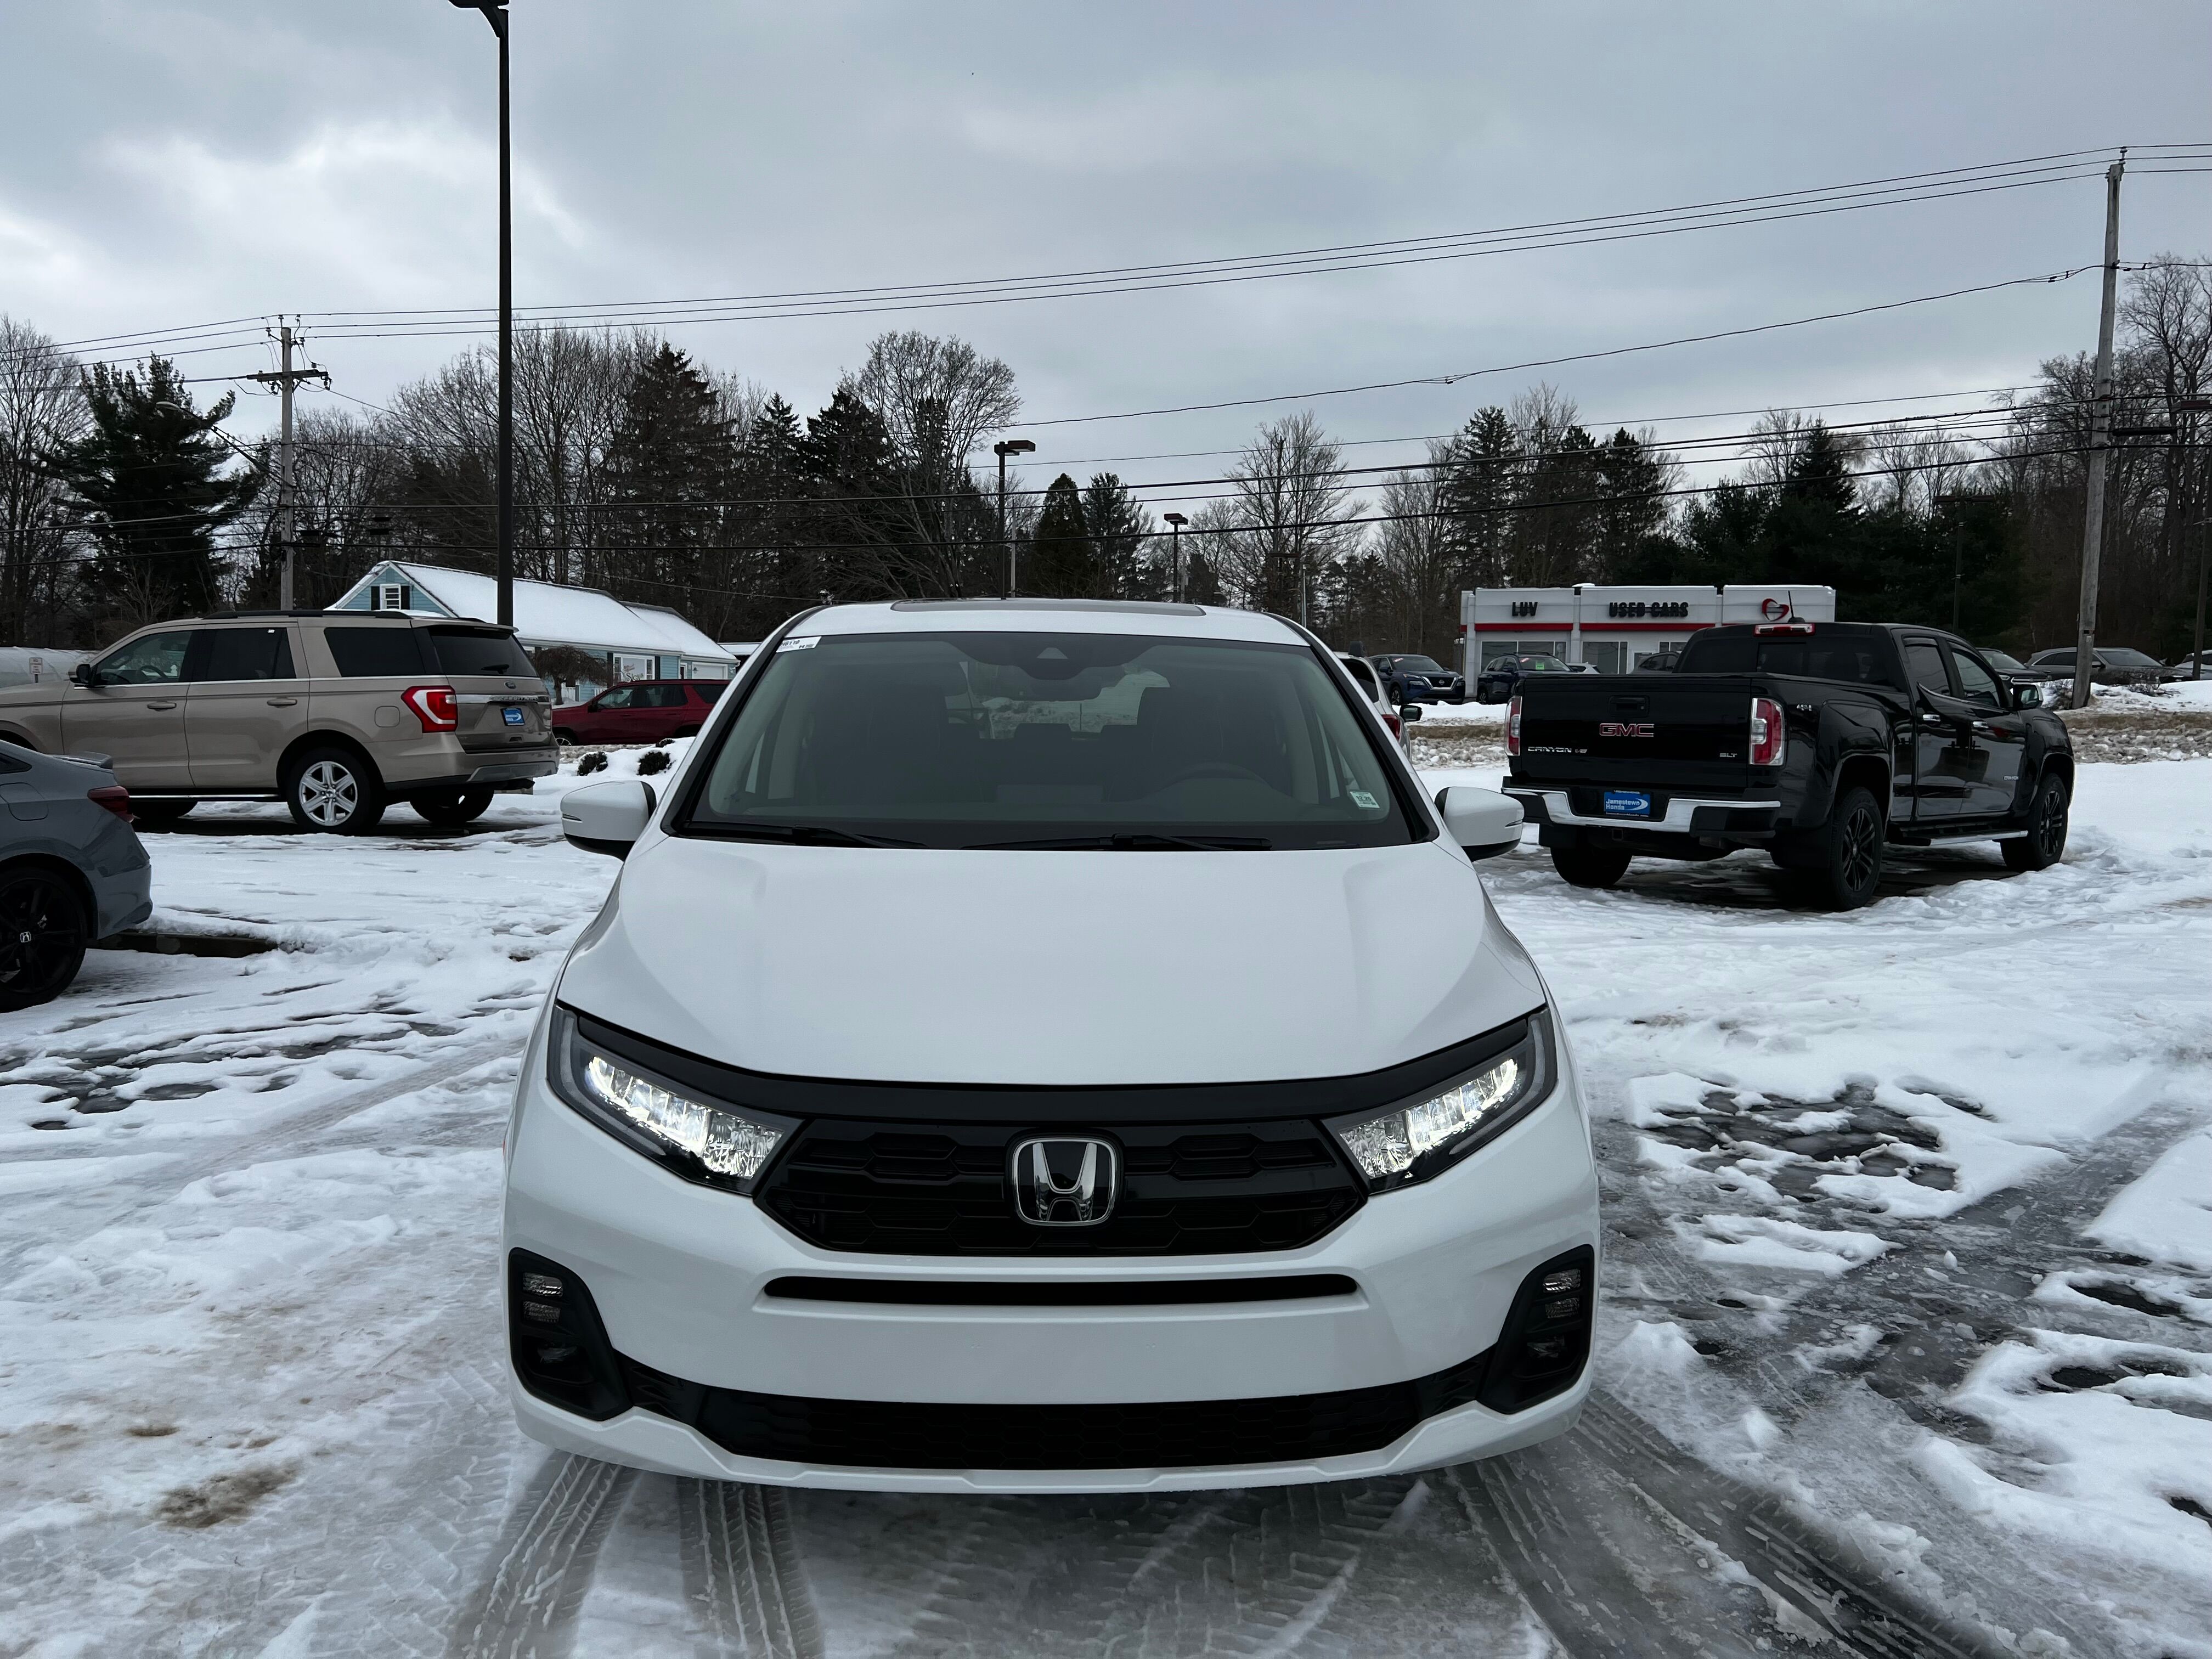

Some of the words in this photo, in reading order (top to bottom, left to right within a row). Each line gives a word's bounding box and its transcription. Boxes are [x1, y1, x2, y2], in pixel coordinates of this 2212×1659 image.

[1511, 601, 1538, 616] LUV
[1609, 602, 1645, 617] USED
[1651, 602, 1689, 617] CARS
[1599, 723, 1655, 737] GMC
